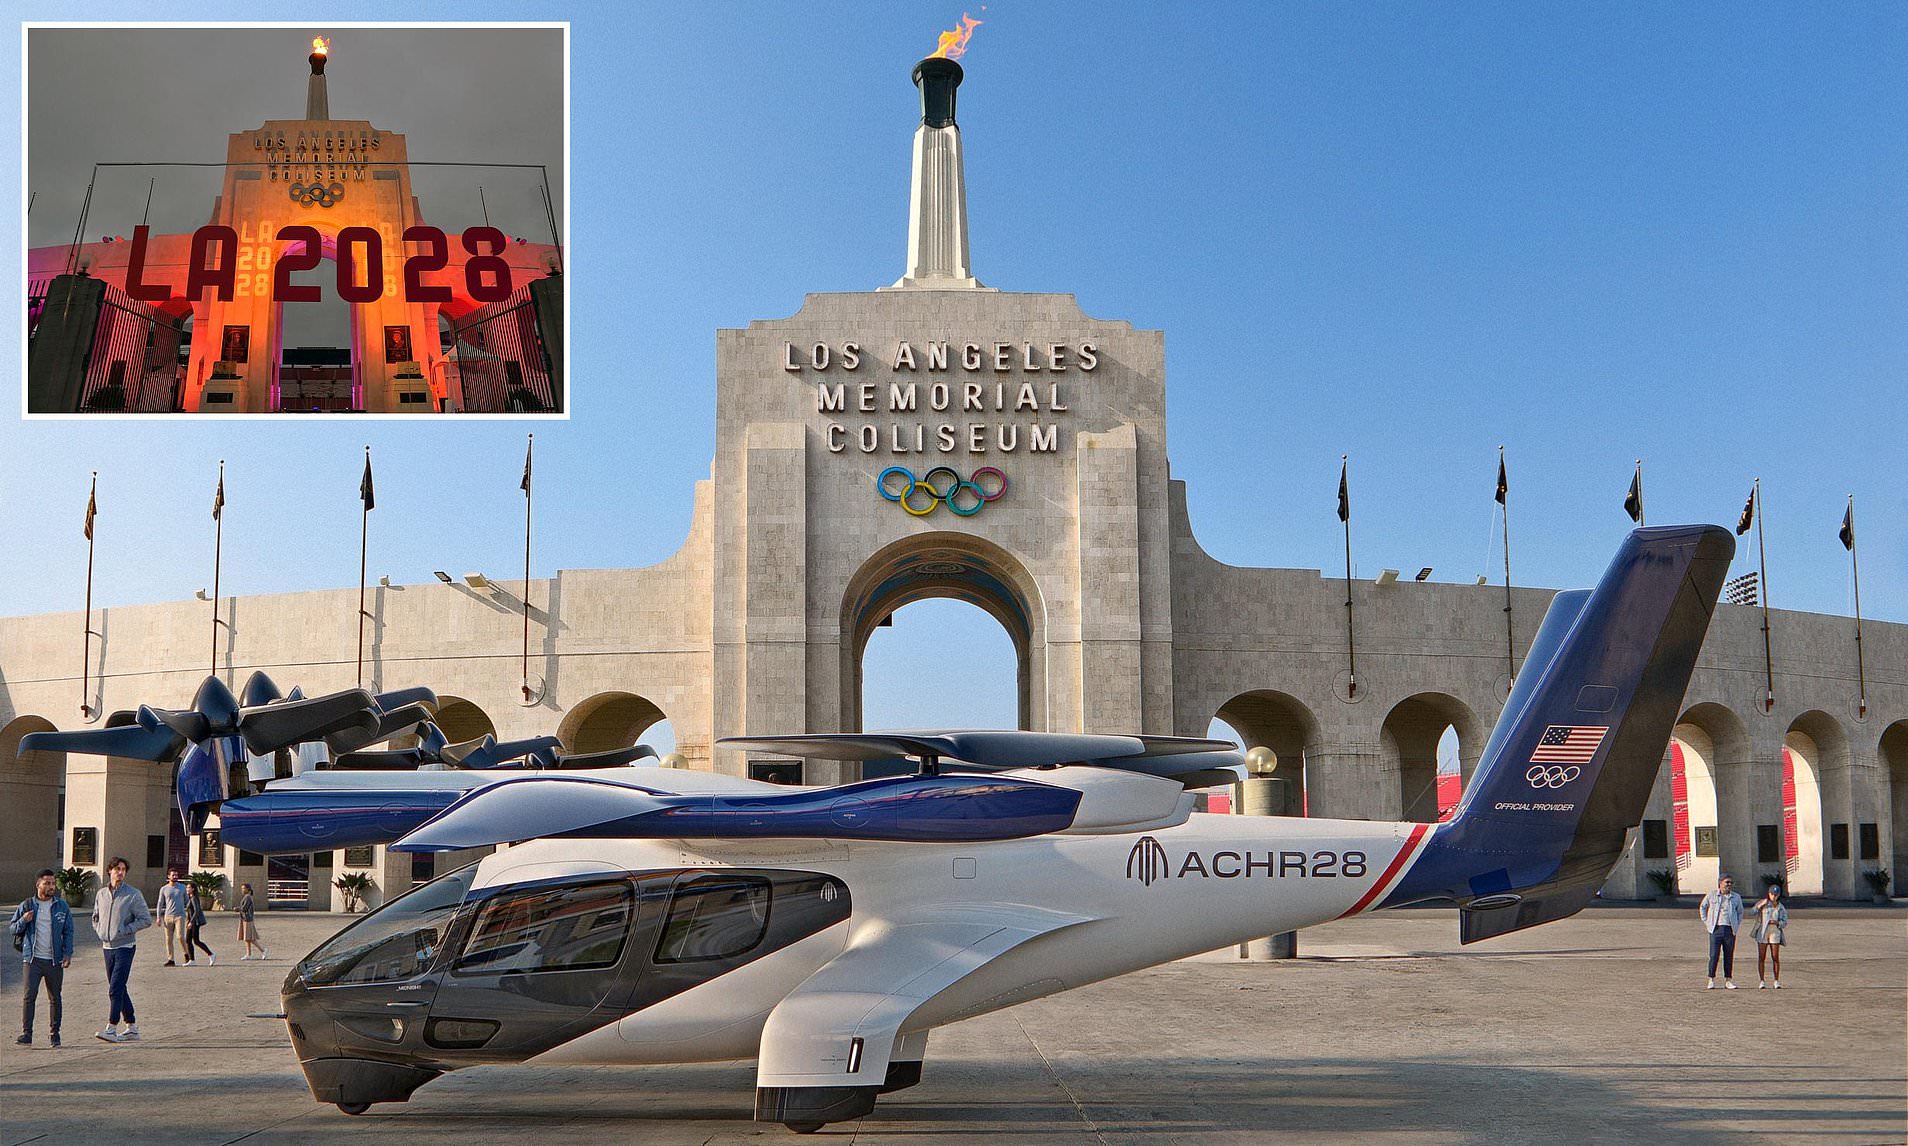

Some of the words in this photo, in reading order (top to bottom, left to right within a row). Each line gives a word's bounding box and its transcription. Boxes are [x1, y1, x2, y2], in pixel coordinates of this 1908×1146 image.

[254, 136, 286, 150] LOS
[297, 136, 381, 151] ANGELES
[266, 152, 369, 164] MEMORIAL
[269, 169, 366, 182] COLISEUM
[241, 221, 274, 244] LA
[125, 225, 238, 302] LA
[272, 225, 513, 303] 2028
[238, 247, 271, 271] 20
[236, 273, 271, 297] 28
[784, 341, 861, 372] LOS
[894, 341, 1099, 373] ANGELES
[818, 382, 1069, 413] MEMORIAL
[826, 423, 1058, 453] COLISEUM
[1495, 802, 1531, 811] OFFICIAL
[1532, 803, 1575, 812] PROVIDER
[1177, 851, 1367, 879] ACHR28
